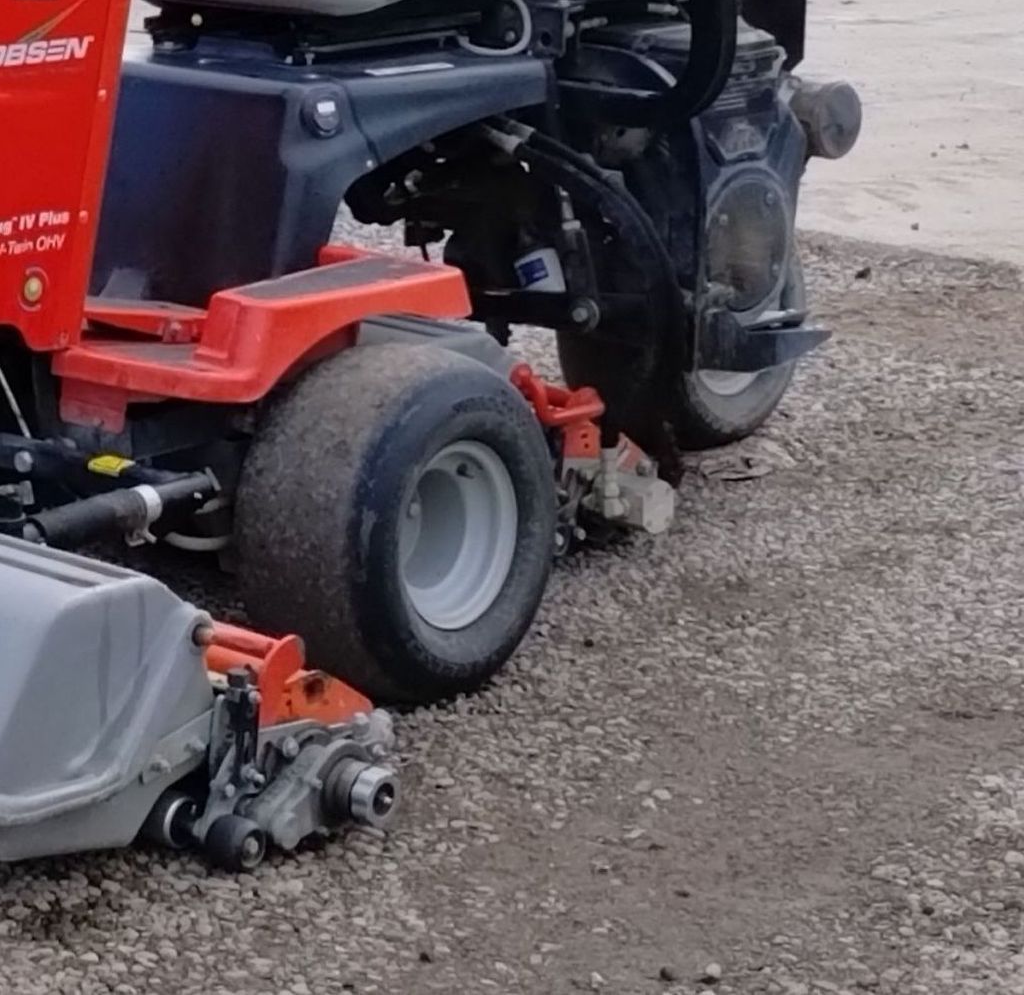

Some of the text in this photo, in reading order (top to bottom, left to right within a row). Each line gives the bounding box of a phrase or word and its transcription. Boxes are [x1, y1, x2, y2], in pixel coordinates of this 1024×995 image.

[19, 213, 36, 230] IV
[38, 210, 70, 227] Plus
[35, 234, 66, 251] OHV
